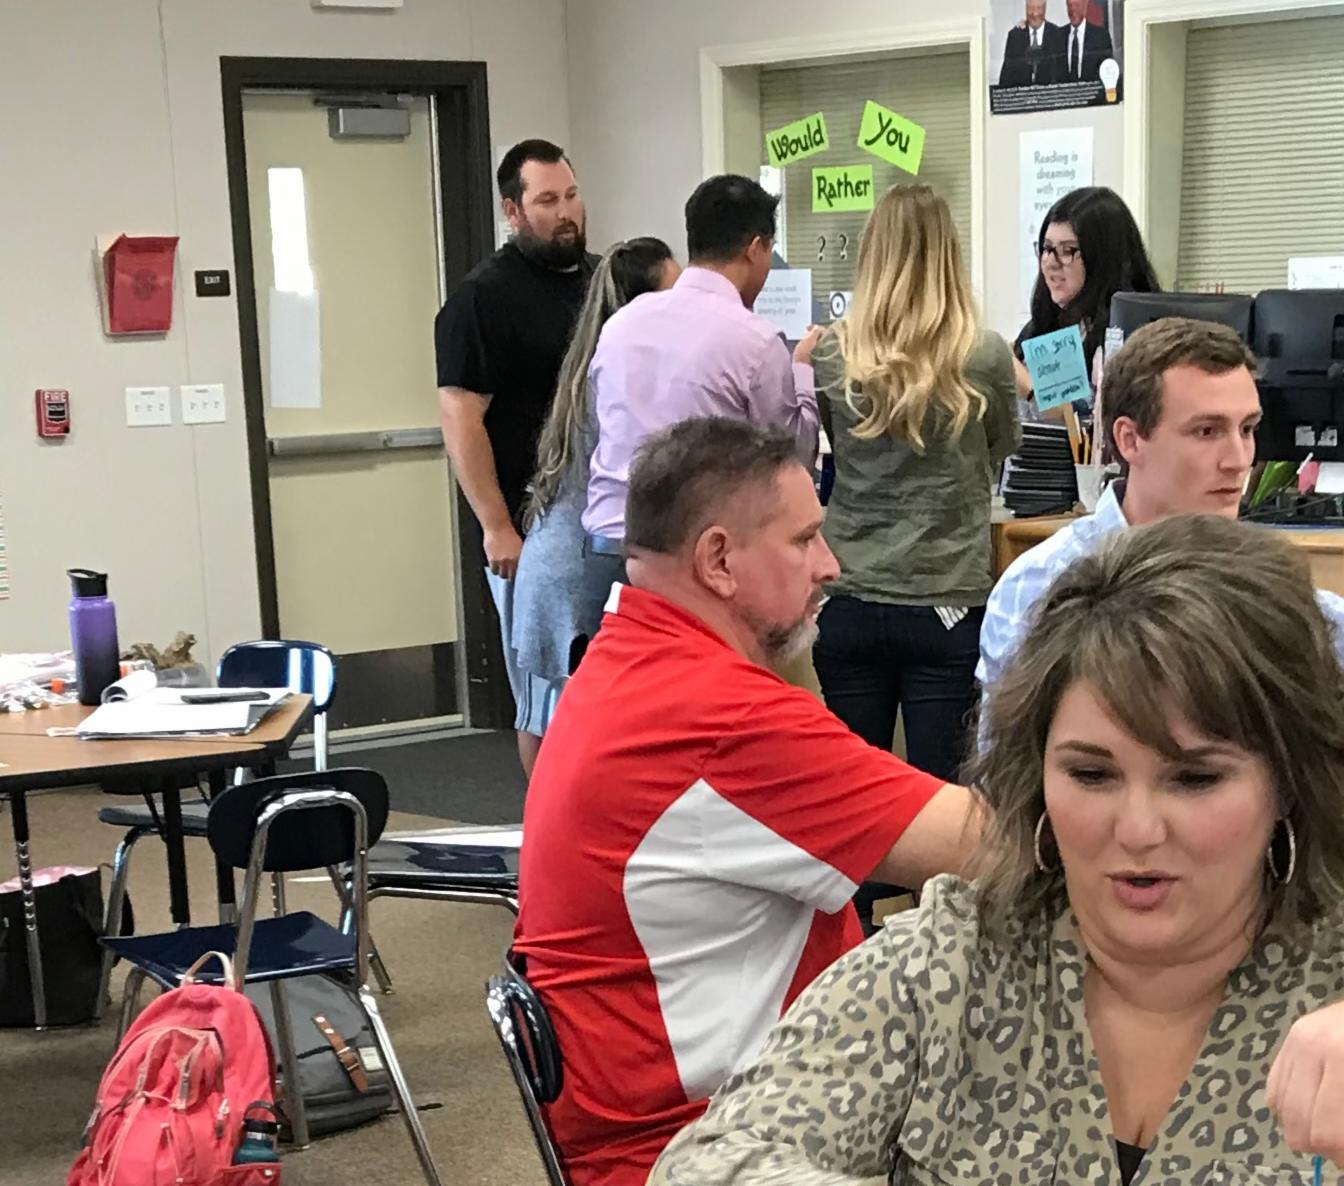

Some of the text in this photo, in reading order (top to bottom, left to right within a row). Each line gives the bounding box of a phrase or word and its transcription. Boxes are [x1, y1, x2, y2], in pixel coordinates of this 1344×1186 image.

[771, 112, 911, 162] Would You
[1034, 150, 1068, 165] Reading
[1037, 167, 1076, 180] dreaming
[816, 172, 870, 207] Rather
[44, 391, 67, 401] FIRE
